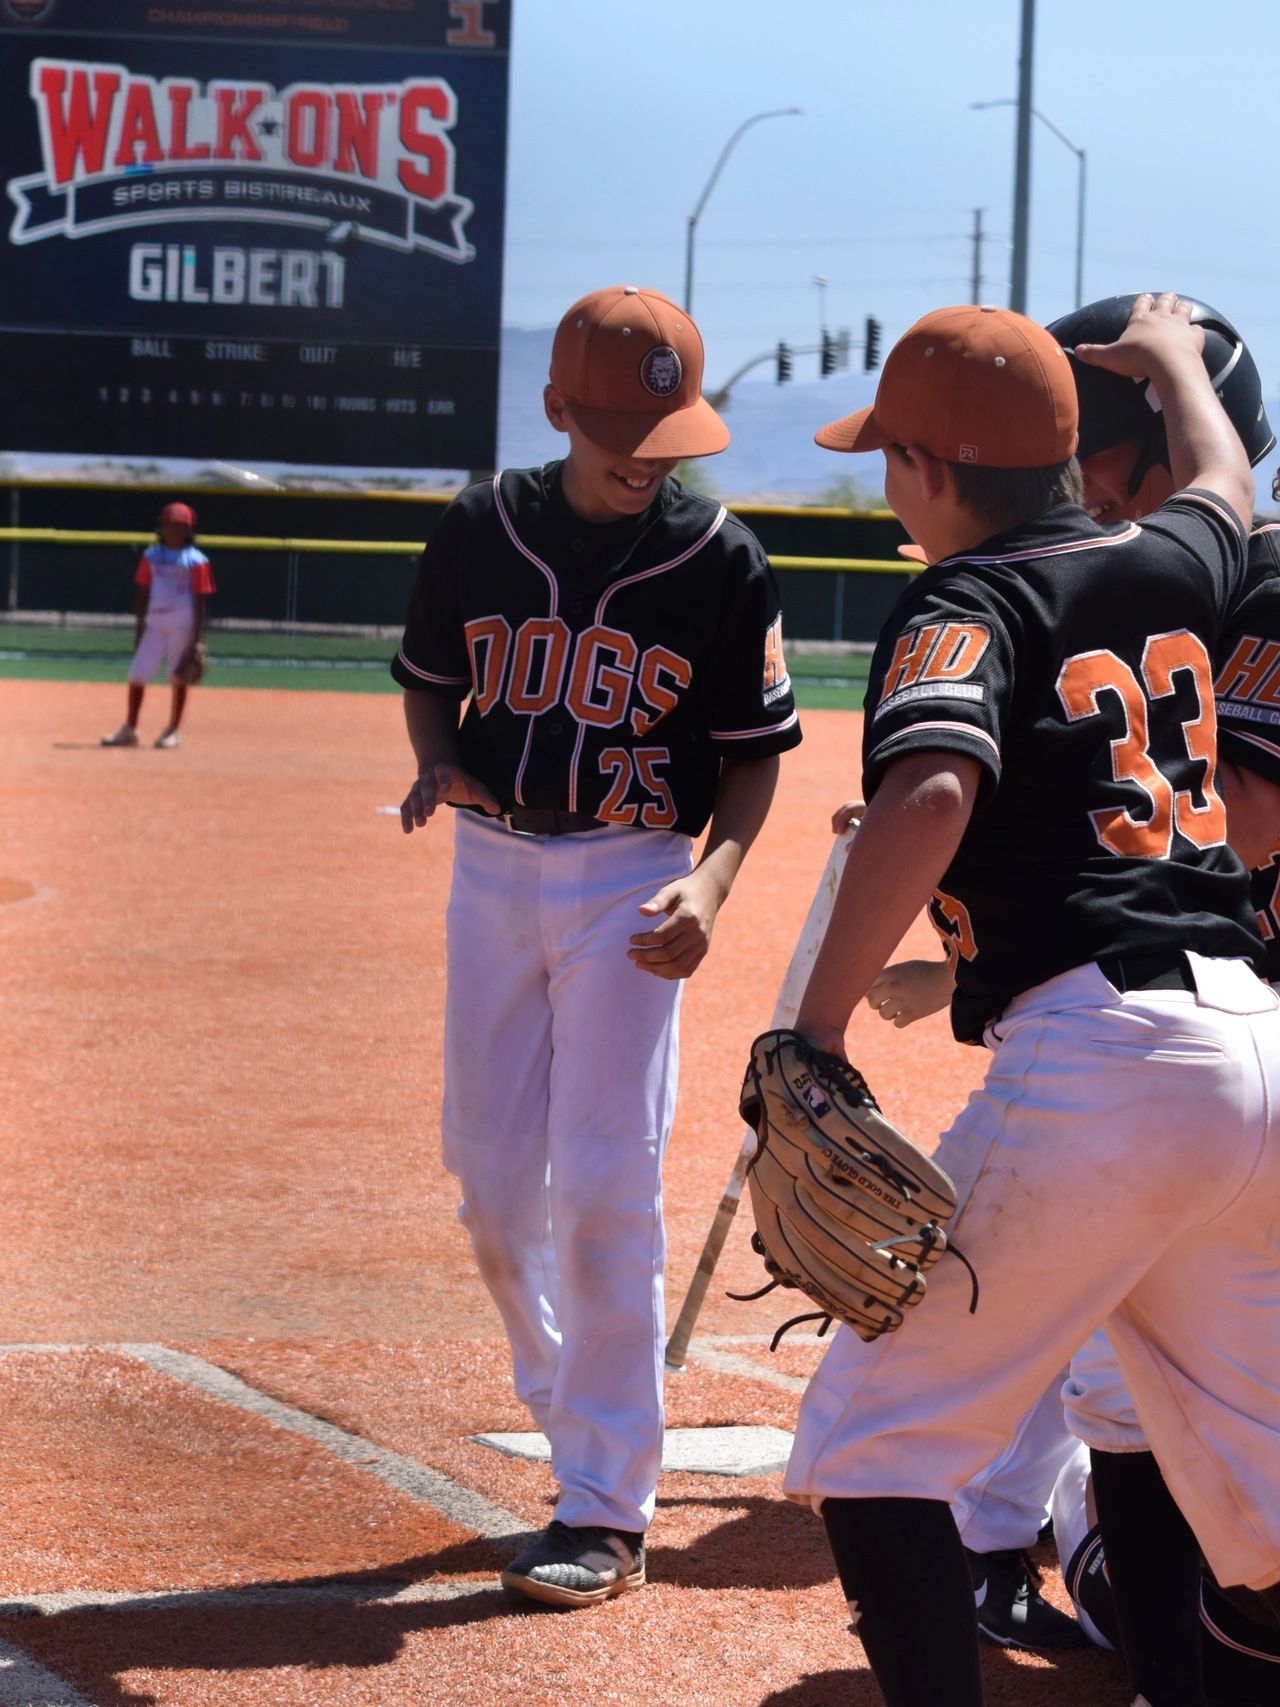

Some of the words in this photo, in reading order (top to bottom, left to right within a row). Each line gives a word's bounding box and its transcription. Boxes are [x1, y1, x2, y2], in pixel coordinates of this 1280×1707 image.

[113, 180, 213, 206] SPORTS
[129, 243, 345, 308] GILBERT
[130, 337, 171, 357] BALL
[204, 341, 265, 361] STRIKE
[300, 345, 338, 364] OUT
[464, 614, 692, 737] DOGS
[878, 621, 991, 703] HD
[1055, 628, 1227, 860] 33
[595, 746, 678, 828] 25
[831, 1155, 859, 1182] GLOVE
[858, 1174, 883, 1198] GOLD
[882, 1192, 902, 1209] THE
